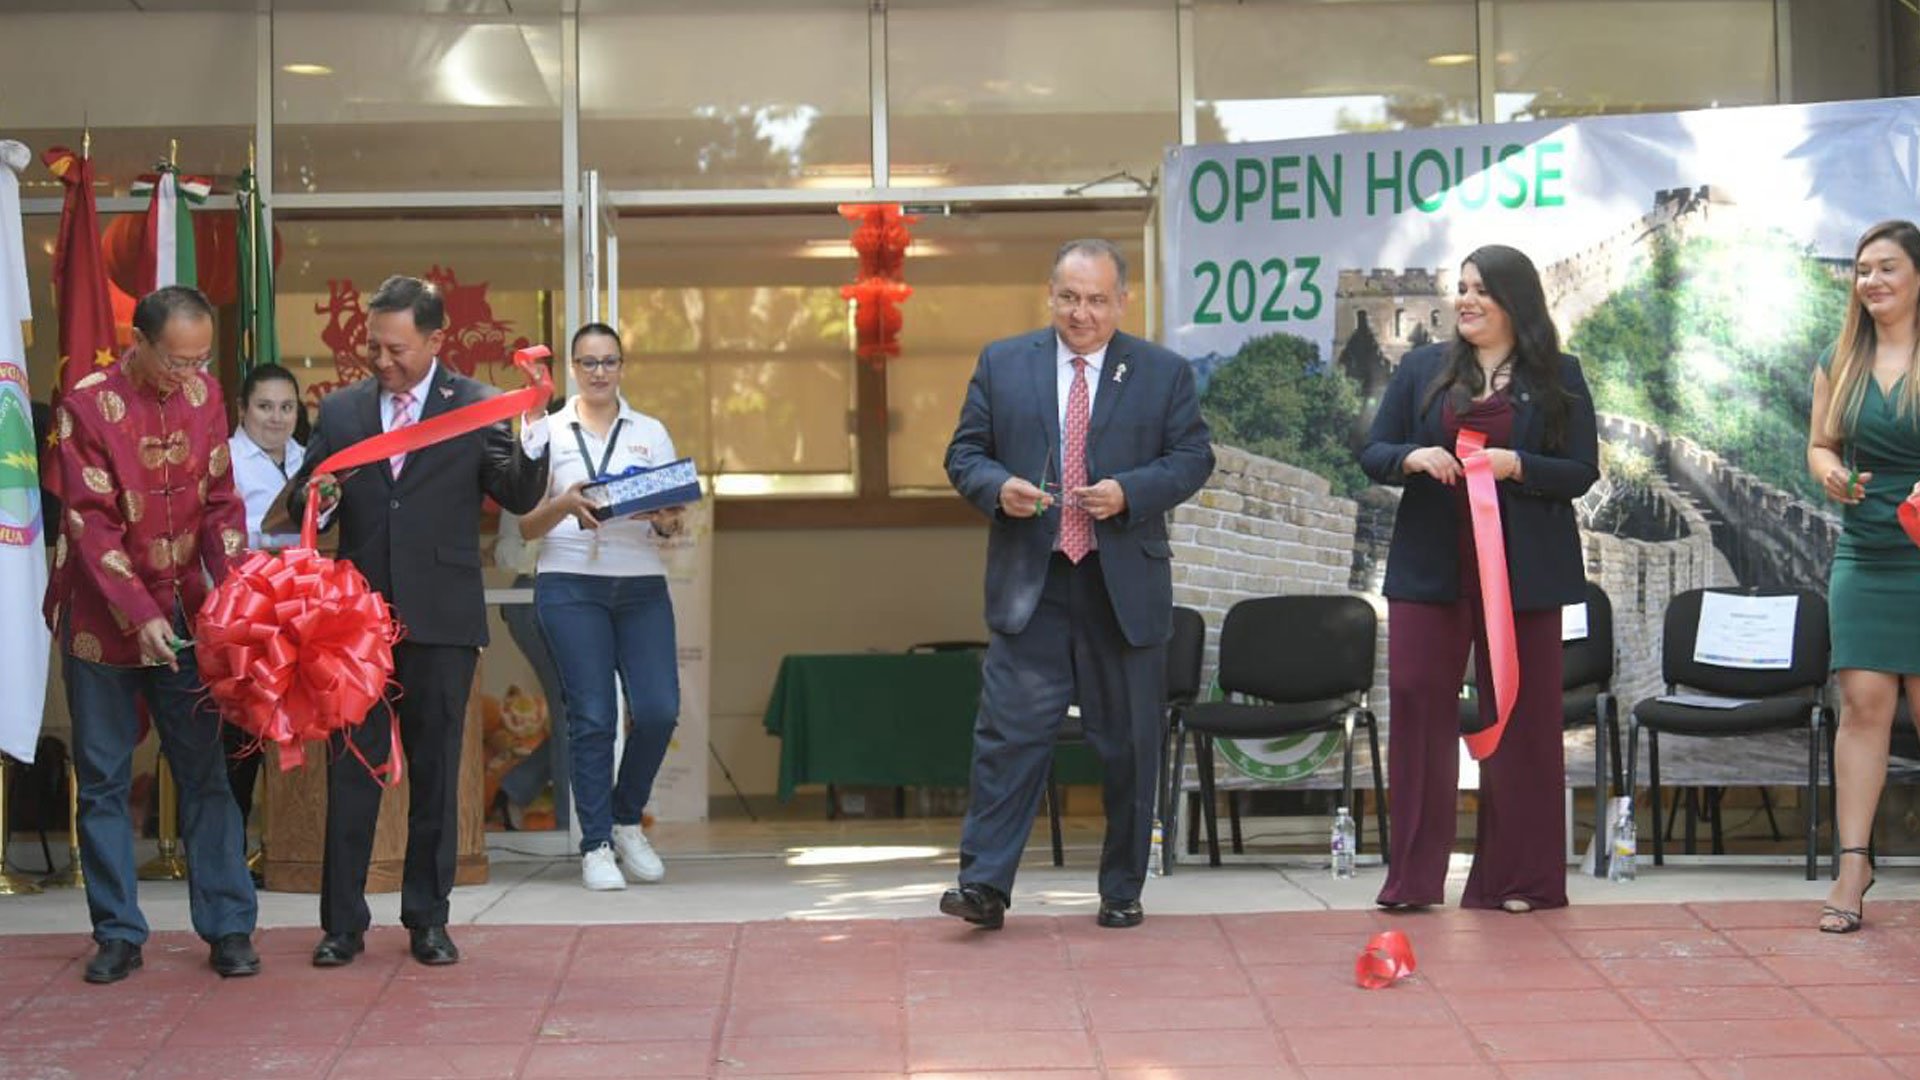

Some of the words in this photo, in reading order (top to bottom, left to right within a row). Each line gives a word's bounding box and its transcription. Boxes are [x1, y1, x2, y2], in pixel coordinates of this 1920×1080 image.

[1189, 153, 1343, 224] OPEN
[1366, 141, 1565, 216] HOUSE
[1193, 257, 1322, 325] 2023
